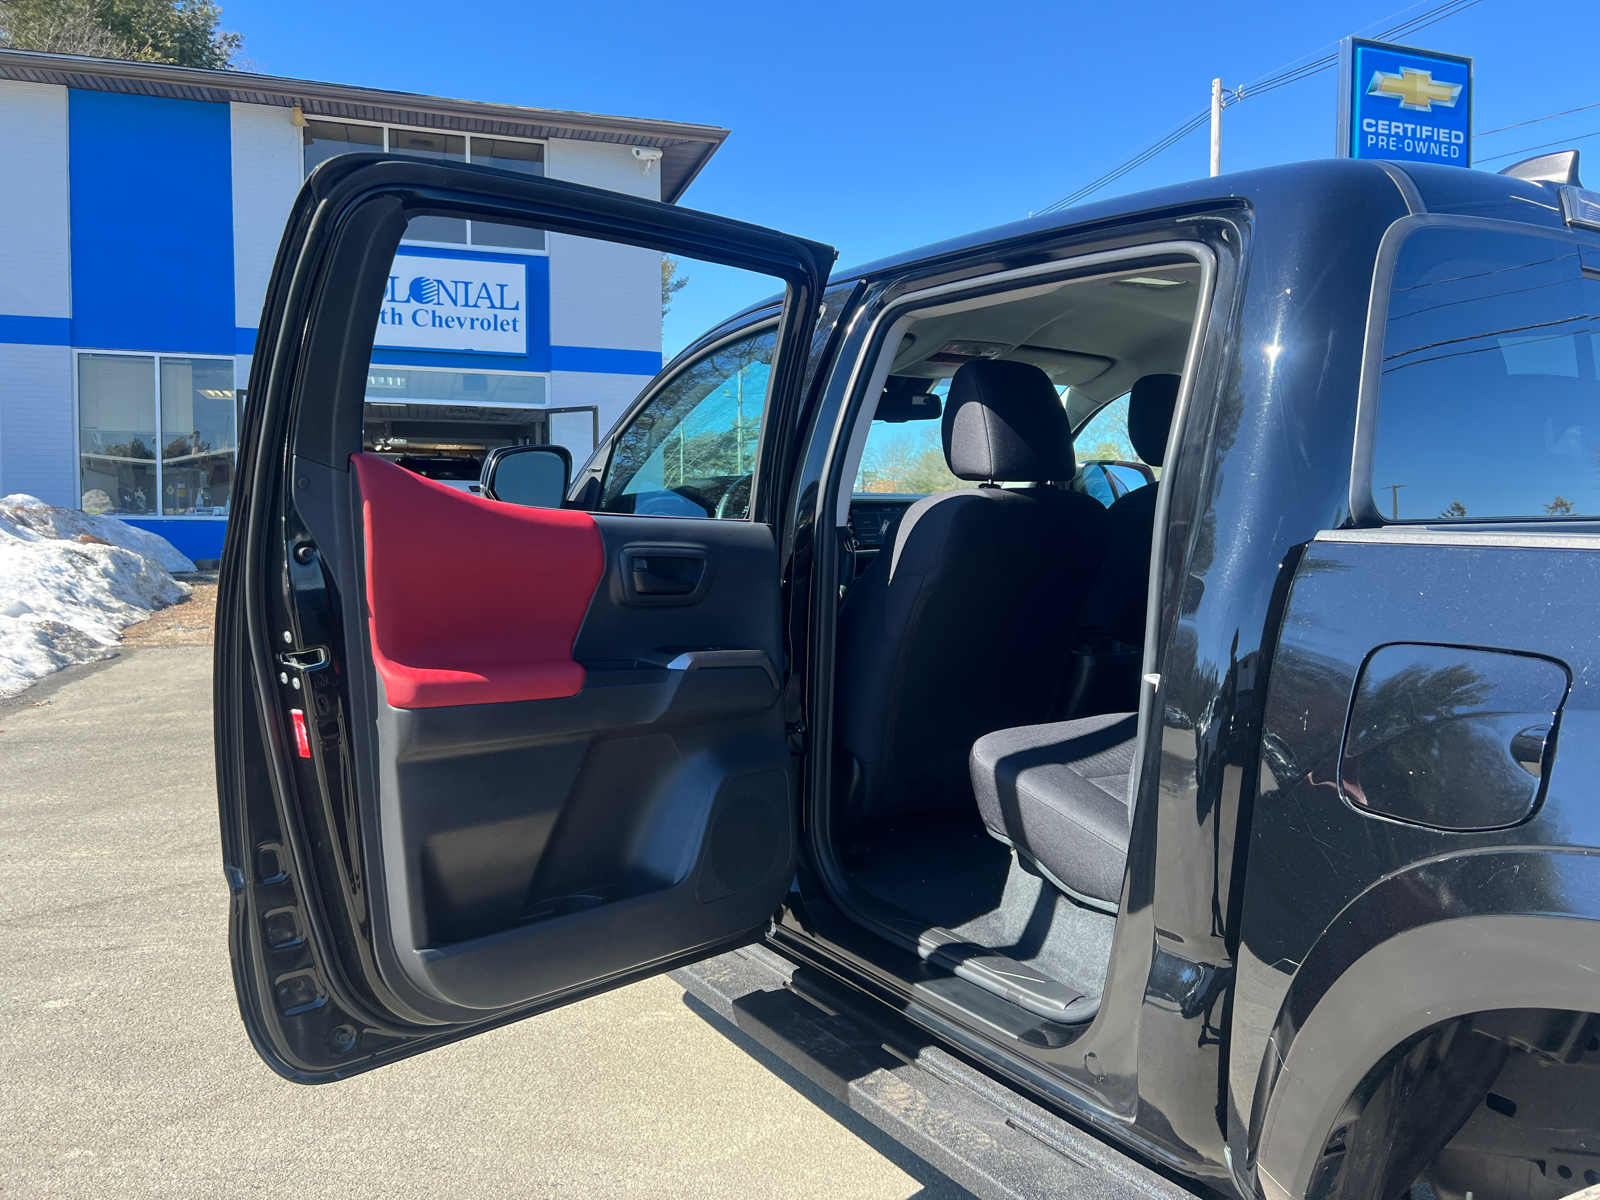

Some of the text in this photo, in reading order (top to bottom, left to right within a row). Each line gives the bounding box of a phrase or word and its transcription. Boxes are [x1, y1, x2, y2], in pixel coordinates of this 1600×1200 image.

[1362, 118, 1464, 144] CERTIFIED
[1367, 135, 1459, 158] PRE-OWNED
[384, 276, 520, 311] LONIAL
[380, 307, 520, 333] th Chevrolet
